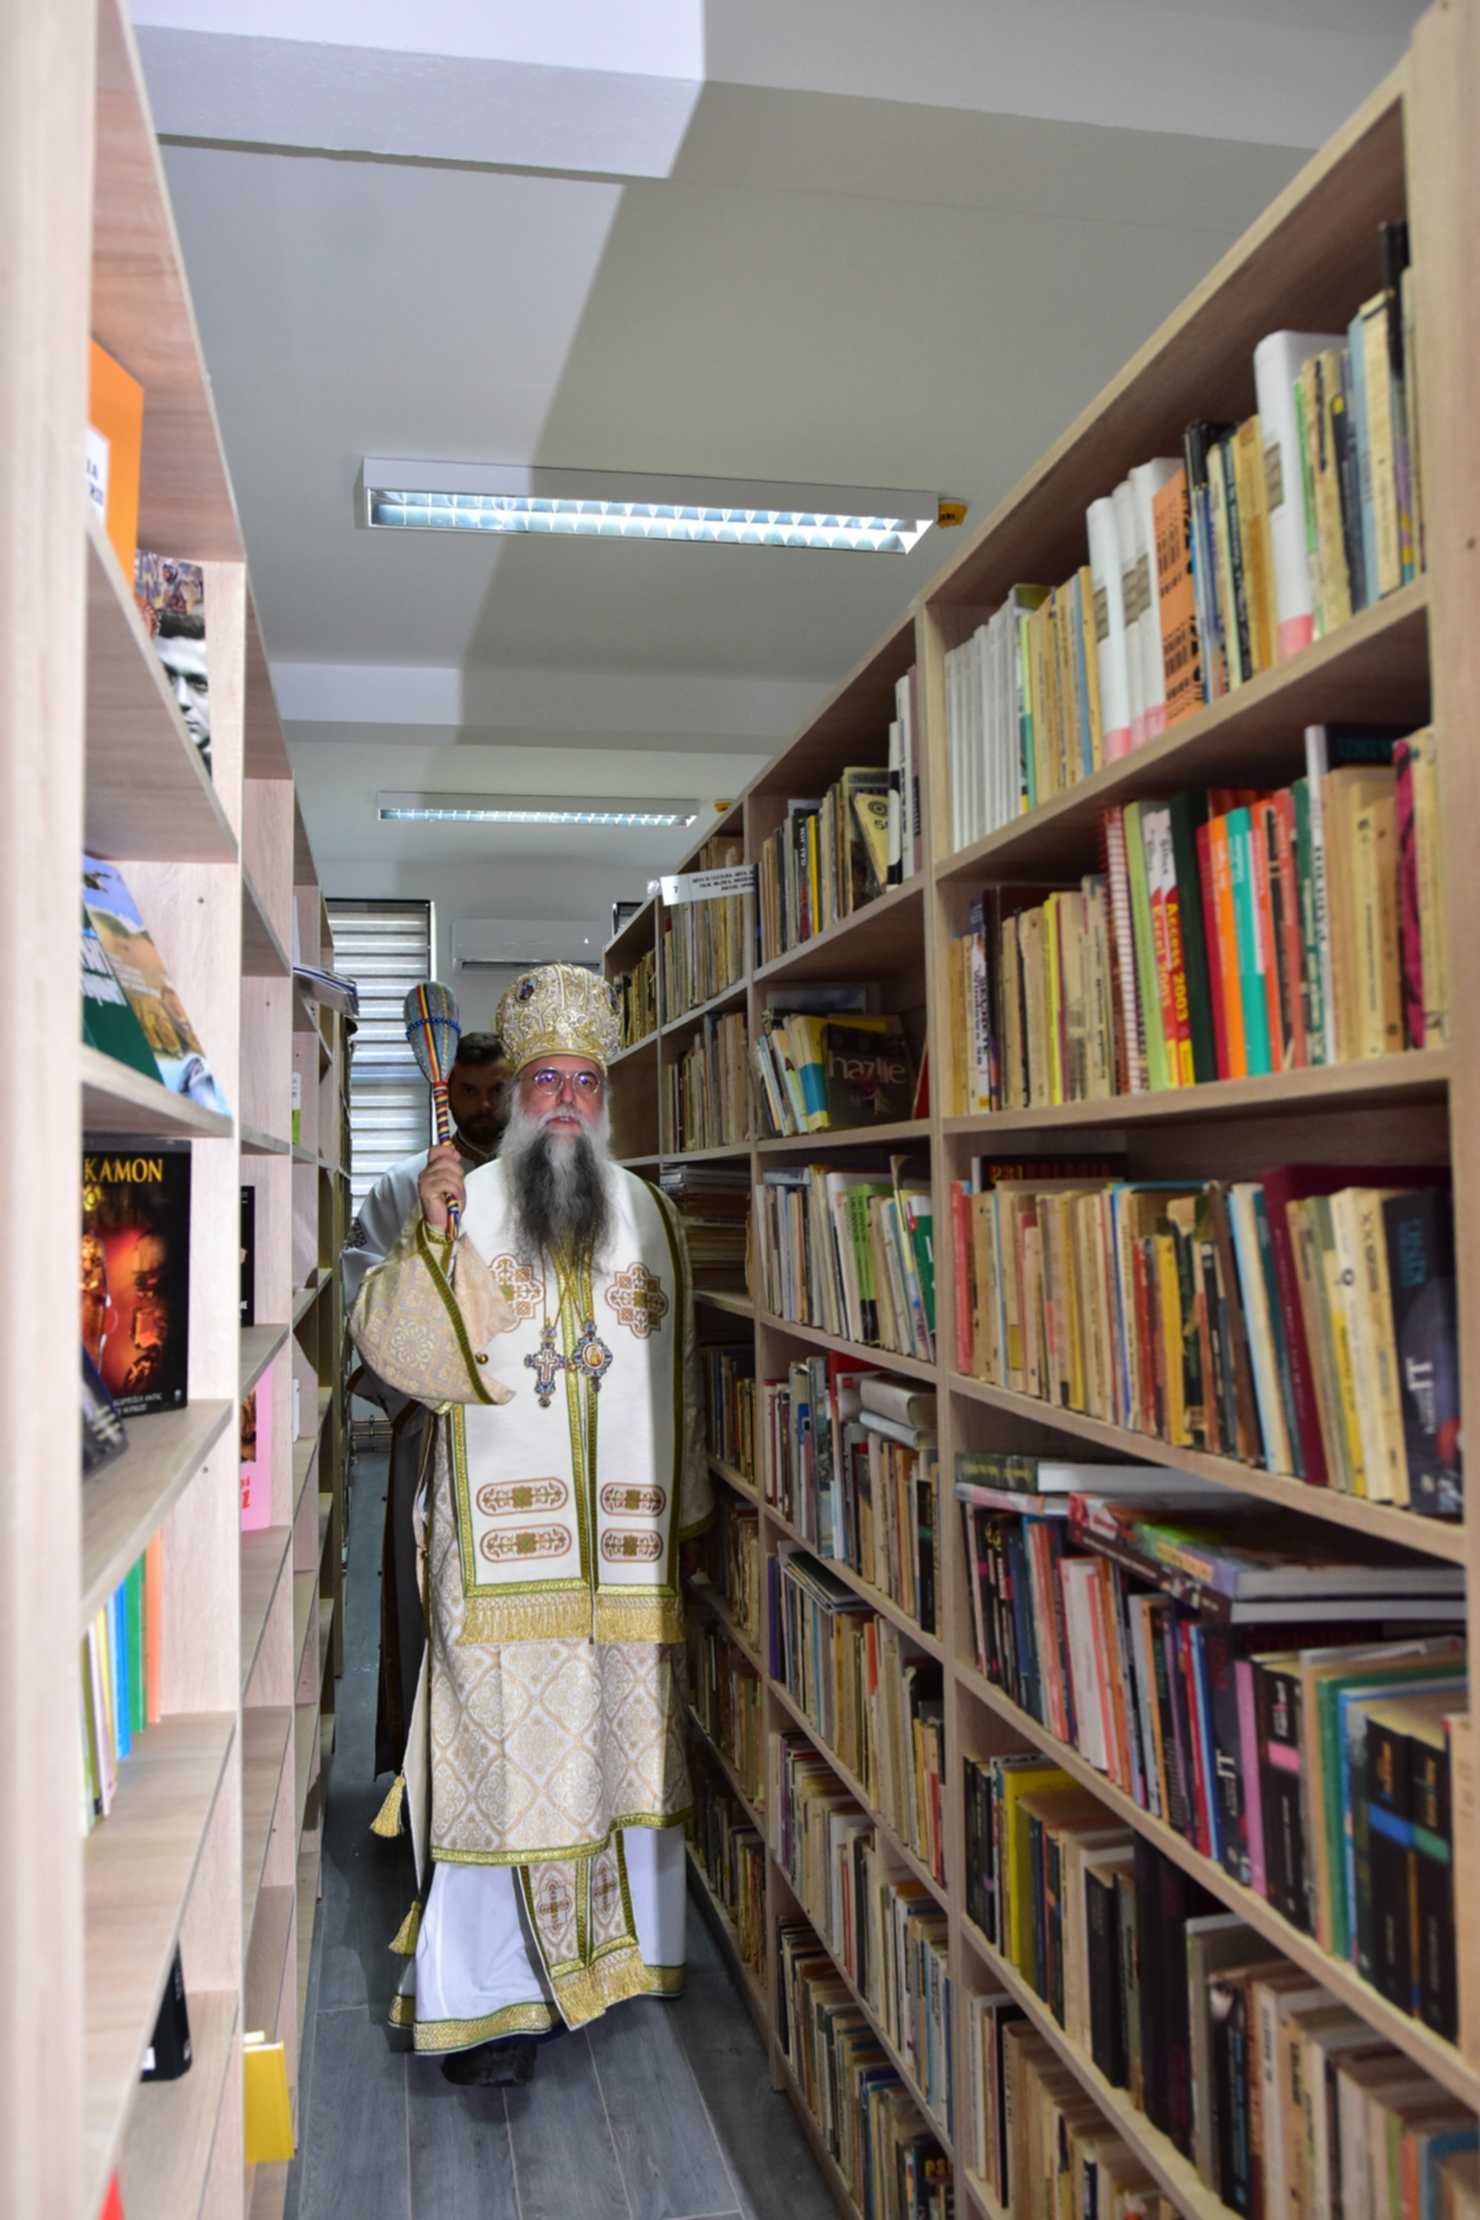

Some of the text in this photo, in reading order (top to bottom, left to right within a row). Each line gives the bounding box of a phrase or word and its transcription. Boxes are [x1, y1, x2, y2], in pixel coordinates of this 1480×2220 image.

[1167, 902, 1188, 1022] Access 2003
[83, 1157, 164, 1183] KAMON
